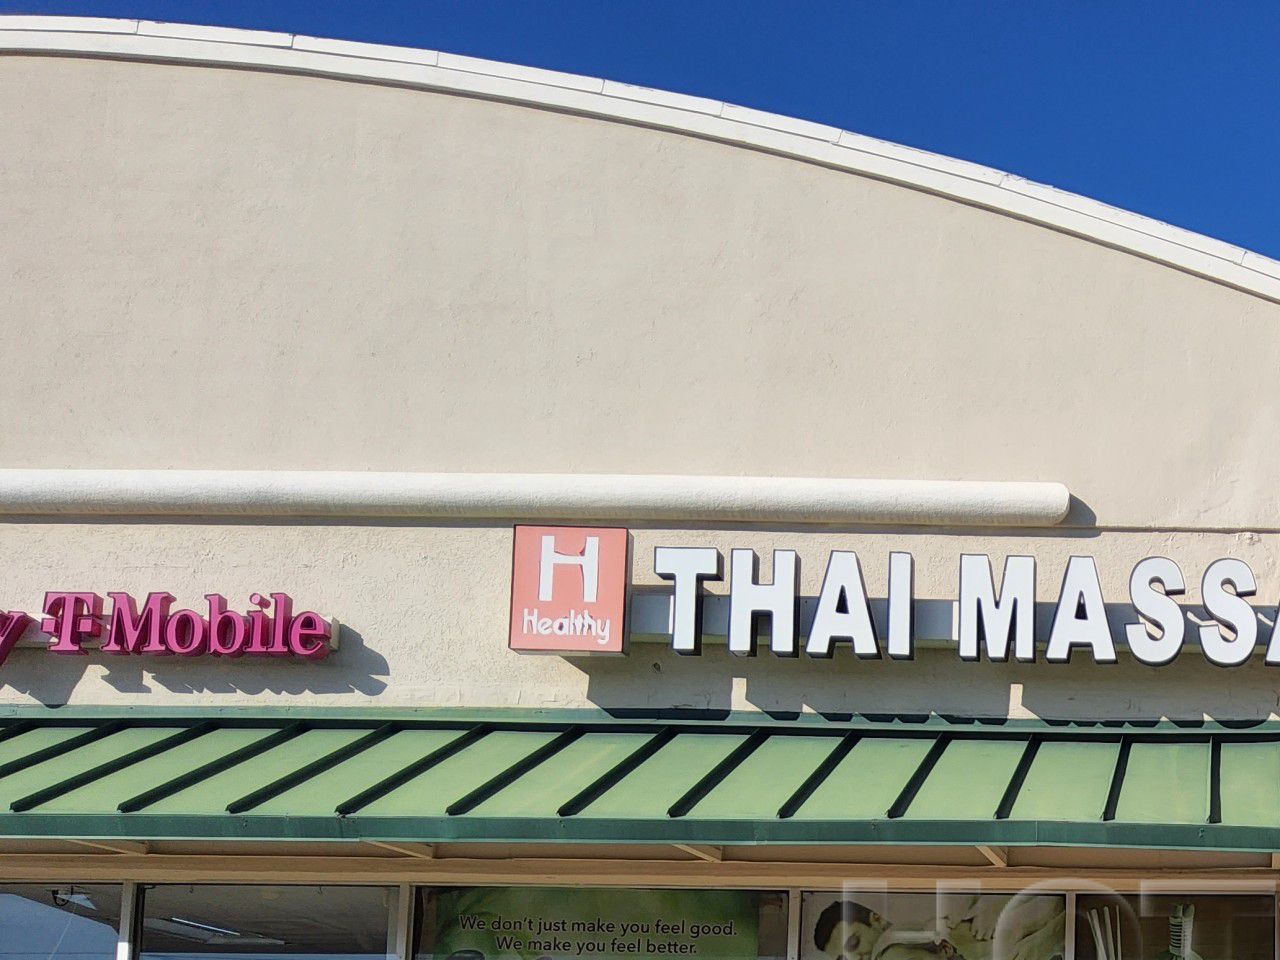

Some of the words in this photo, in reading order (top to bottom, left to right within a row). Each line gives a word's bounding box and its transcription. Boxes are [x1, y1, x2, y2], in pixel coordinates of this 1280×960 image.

[539, 536, 599, 602] H
[653, 547, 913, 662] THAI
[523, 608, 610, 645] Healthy
[460, 916, 486, 930] We
[491, 916, 534, 931] don't
[537, 918, 567, 936] just
[571, 918, 616, 934] make
[620, 922, 650, 937] you
[654, 919, 686, 935] feel
[690, 921, 739, 939] good.
[496, 936, 523, 951] We
[527, 937, 572, 952] make
[576, 941, 606, 956] you
[611, 938, 642, 953] feel
[646, 939, 698, 955] better.
